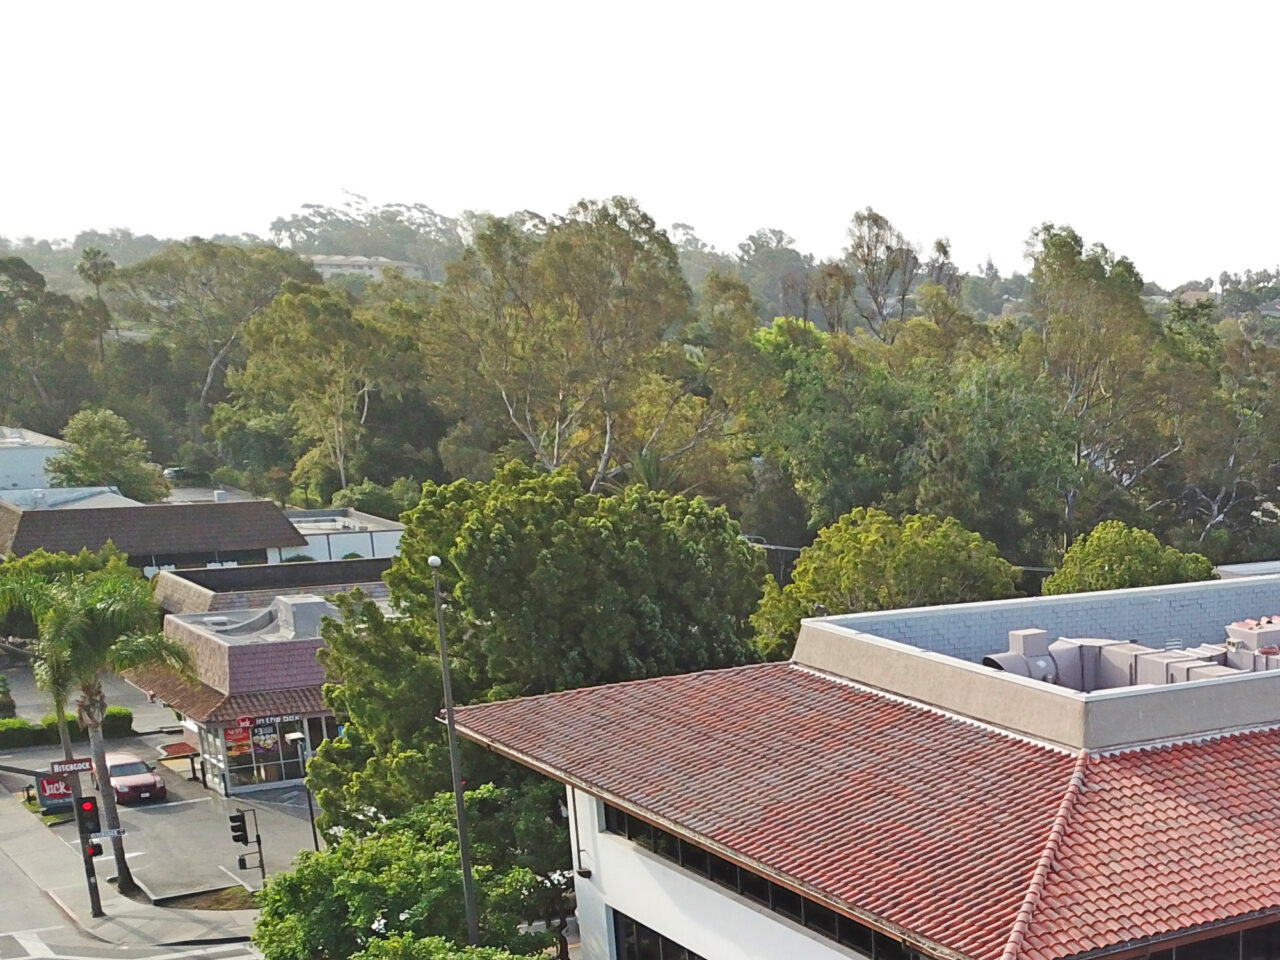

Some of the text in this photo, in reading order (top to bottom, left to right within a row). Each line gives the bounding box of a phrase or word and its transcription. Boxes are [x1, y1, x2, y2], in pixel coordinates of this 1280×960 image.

[256, 717, 265, 725] in
[282, 714, 300, 722] box
[42, 779, 72, 796] Jack
